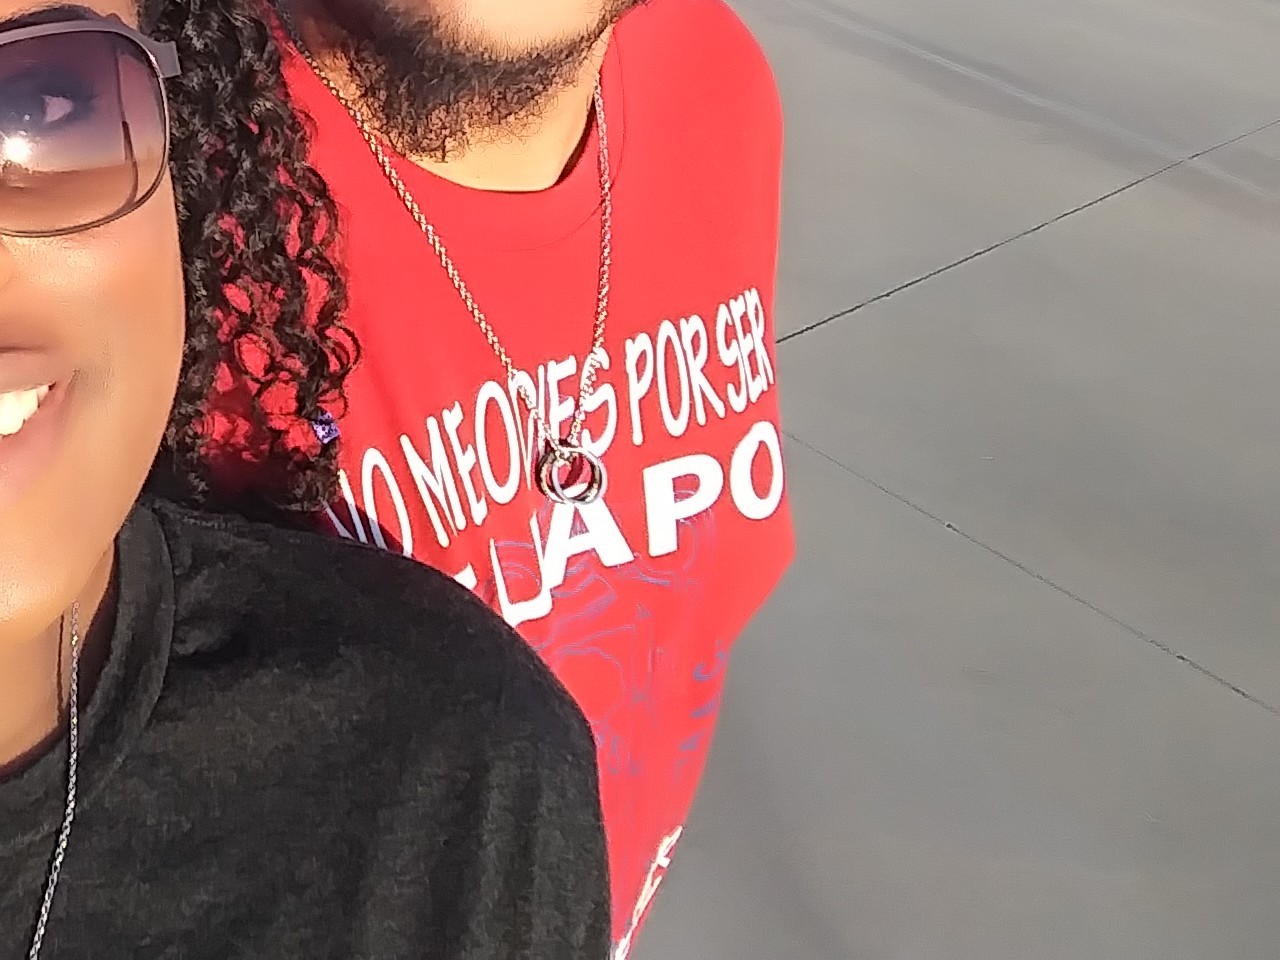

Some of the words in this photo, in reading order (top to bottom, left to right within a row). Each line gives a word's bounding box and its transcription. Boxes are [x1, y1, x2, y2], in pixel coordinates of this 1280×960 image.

[625, 313, 725, 445] POR
[716, 286, 775, 414] SER
[453, 421, 784, 626] UAPO
